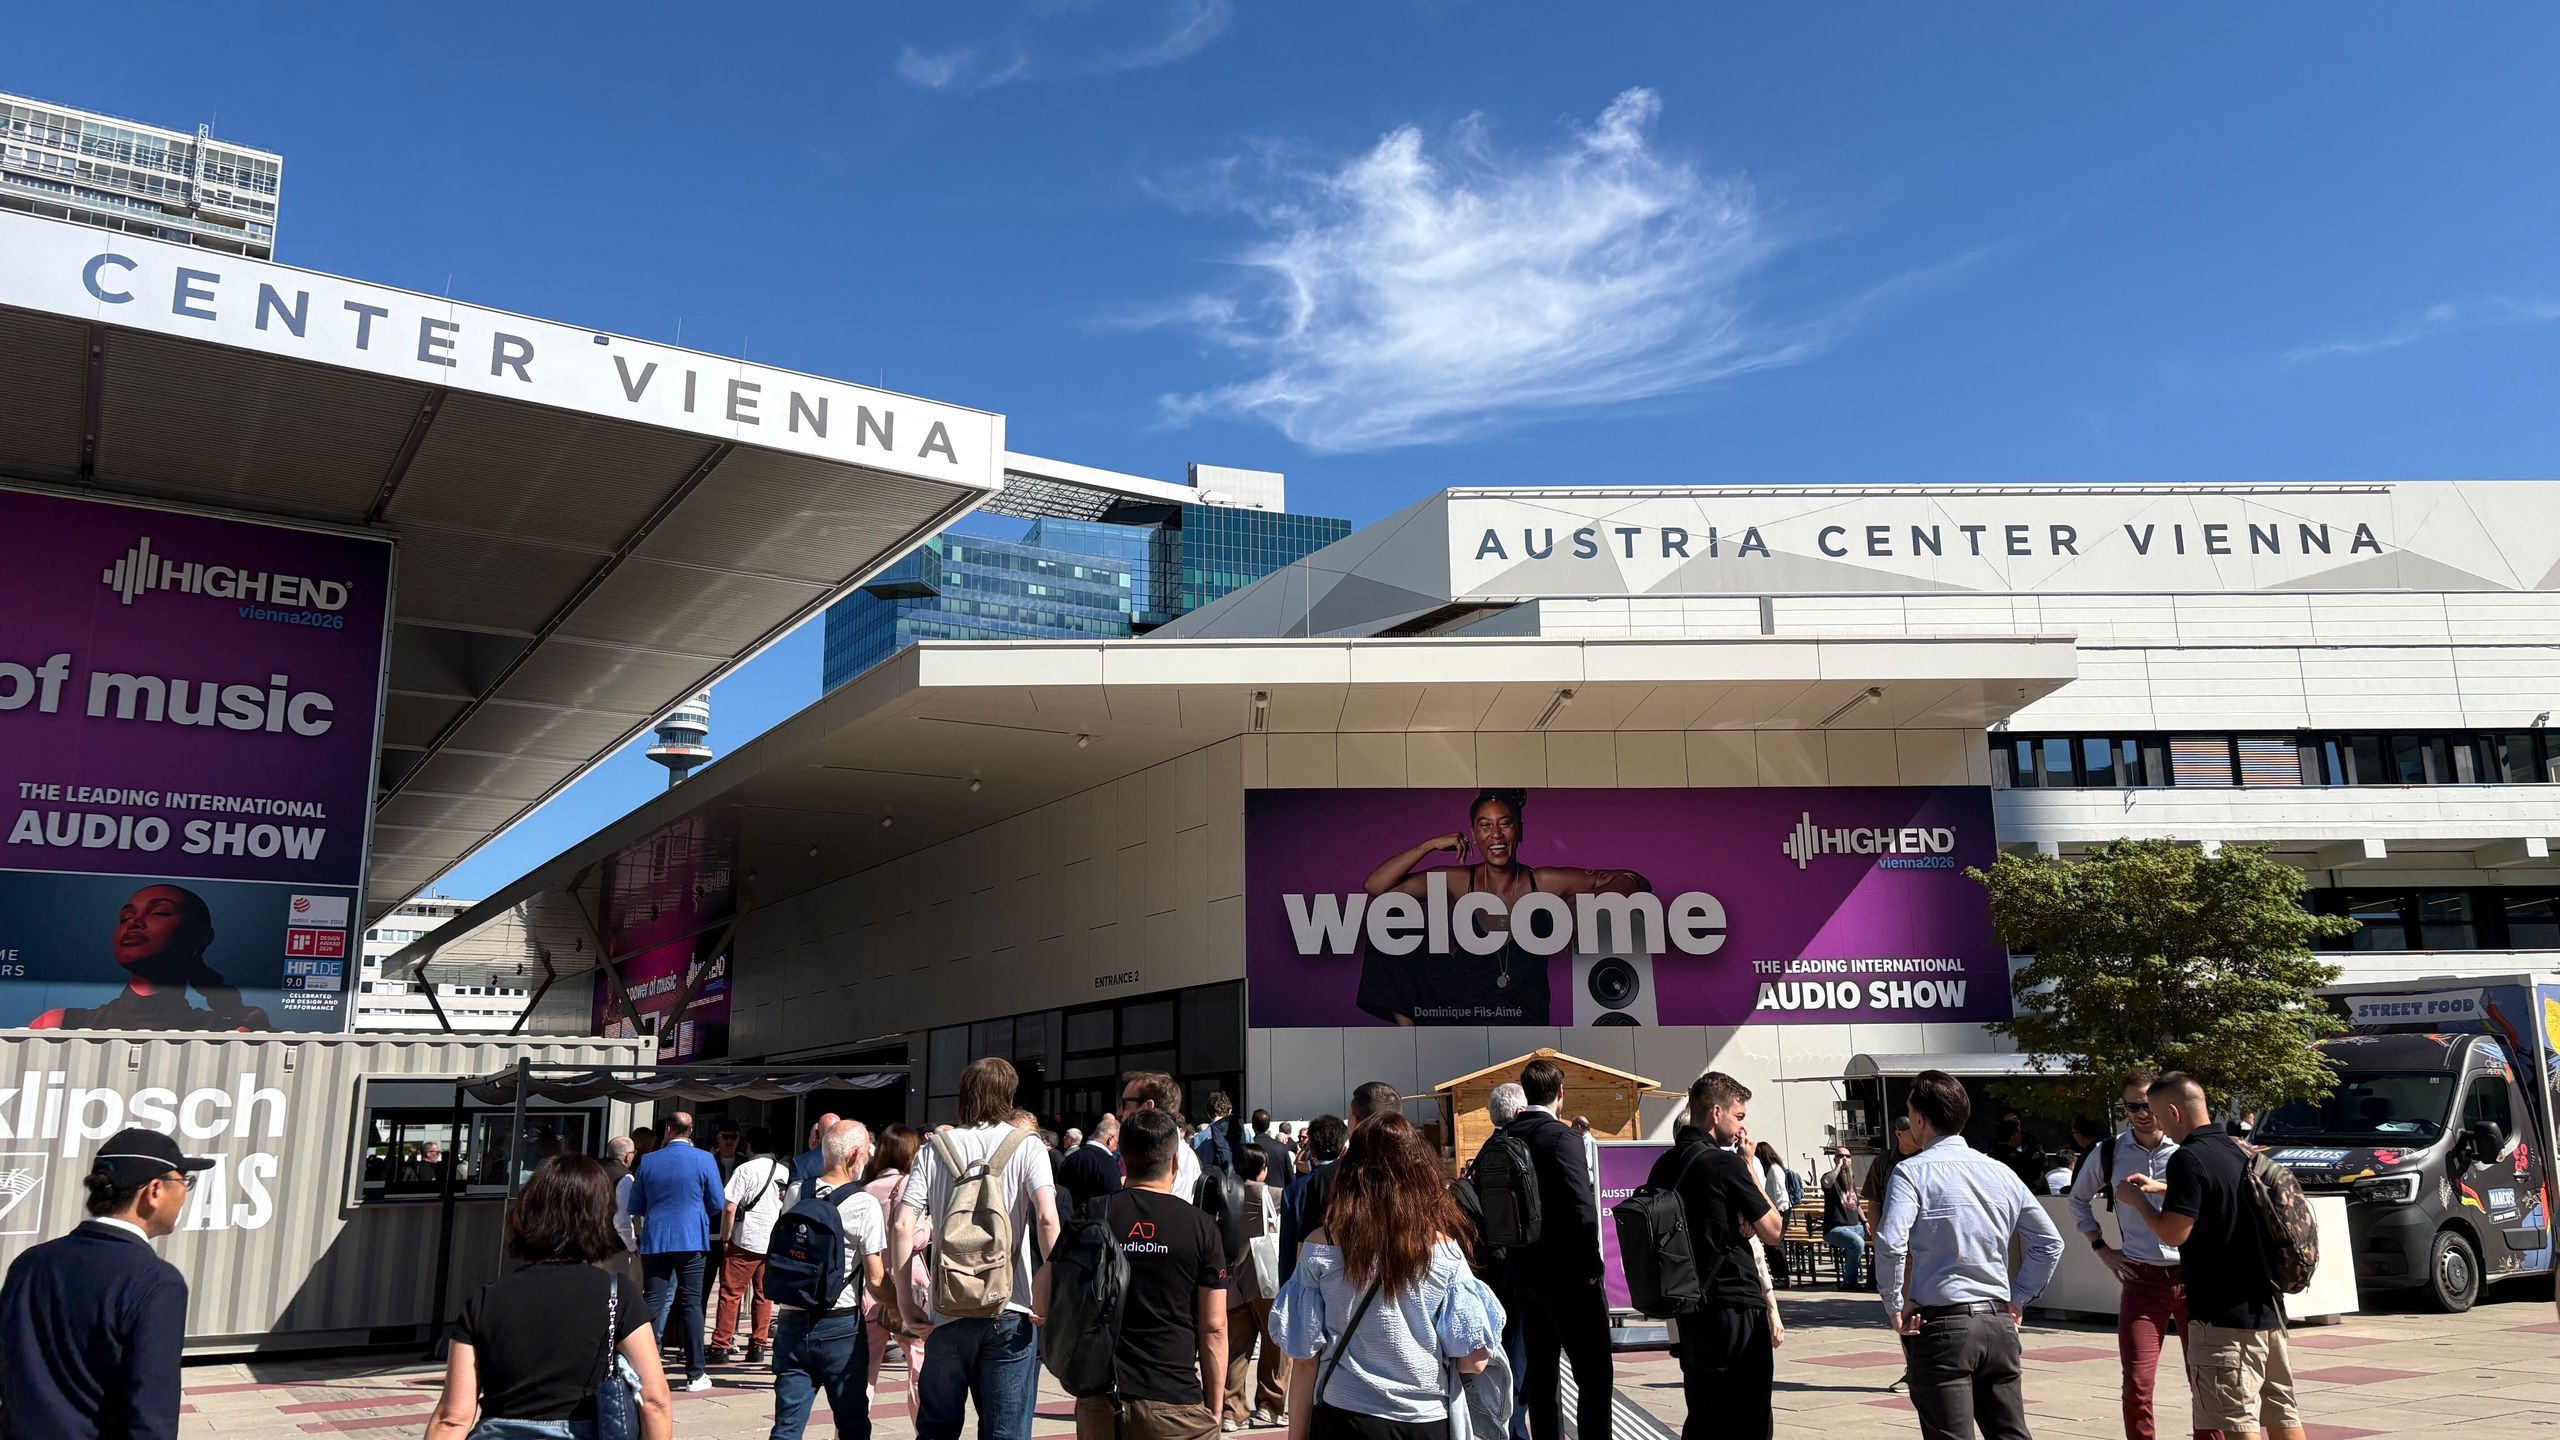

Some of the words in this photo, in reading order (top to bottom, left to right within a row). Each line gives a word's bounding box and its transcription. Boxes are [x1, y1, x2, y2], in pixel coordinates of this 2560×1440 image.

[82, 252, 535, 383] CENTER
[613, 355, 958, 465] VIENNA
[1474, 526, 1771, 560] AUSTRIA
[1817, 524, 2080, 557] CENTER
[2124, 523, 2384, 555] VIENNA
[238, 604, 344, 630] vienna2026
[0, 653, 71, 713] of
[87, 673, 335, 737] music
[18, 782, 60, 801] THE
[65, 785, 160, 807] LEADING
[165, 792, 327, 819] INTERNATIONAL
[7, 809, 171, 852] AUDIO
[181, 819, 327, 860] SHOW
[1878, 856, 1955, 869] vienna2026
[1282, 871, 1728, 956] welcome
[287, 961, 341, 976] HIFI.DE
[1752, 960, 1781, 974] THE
[1785, 959, 1848, 973] LEADING
[1851, 958, 1965, 973] INTERNATIONAL
[286, 977, 303, 987] 9.0
[1095, 971, 1133, 988] ENTRANCE
[1134, 970, 1139, 982] 2
[1756, 980, 1861, 1010] AUDIO
[1868, 980, 1967, 1009] SHOW
[1414, 1006, 1471, 1019] Dominique
[1474, 1006, 1522, 1017] Fils-Aimé
[2358, 1002, 2423, 1017] STREET
[2427, 998, 2475, 1015] FOOD
[2277, 1149, 2345, 1159] MARCOS
[1601, 1188, 1636, 1198] AUSSTE
[2490, 1190, 2515, 1206] MARCOS
[1120, 1241, 1168, 1254] udioDim
